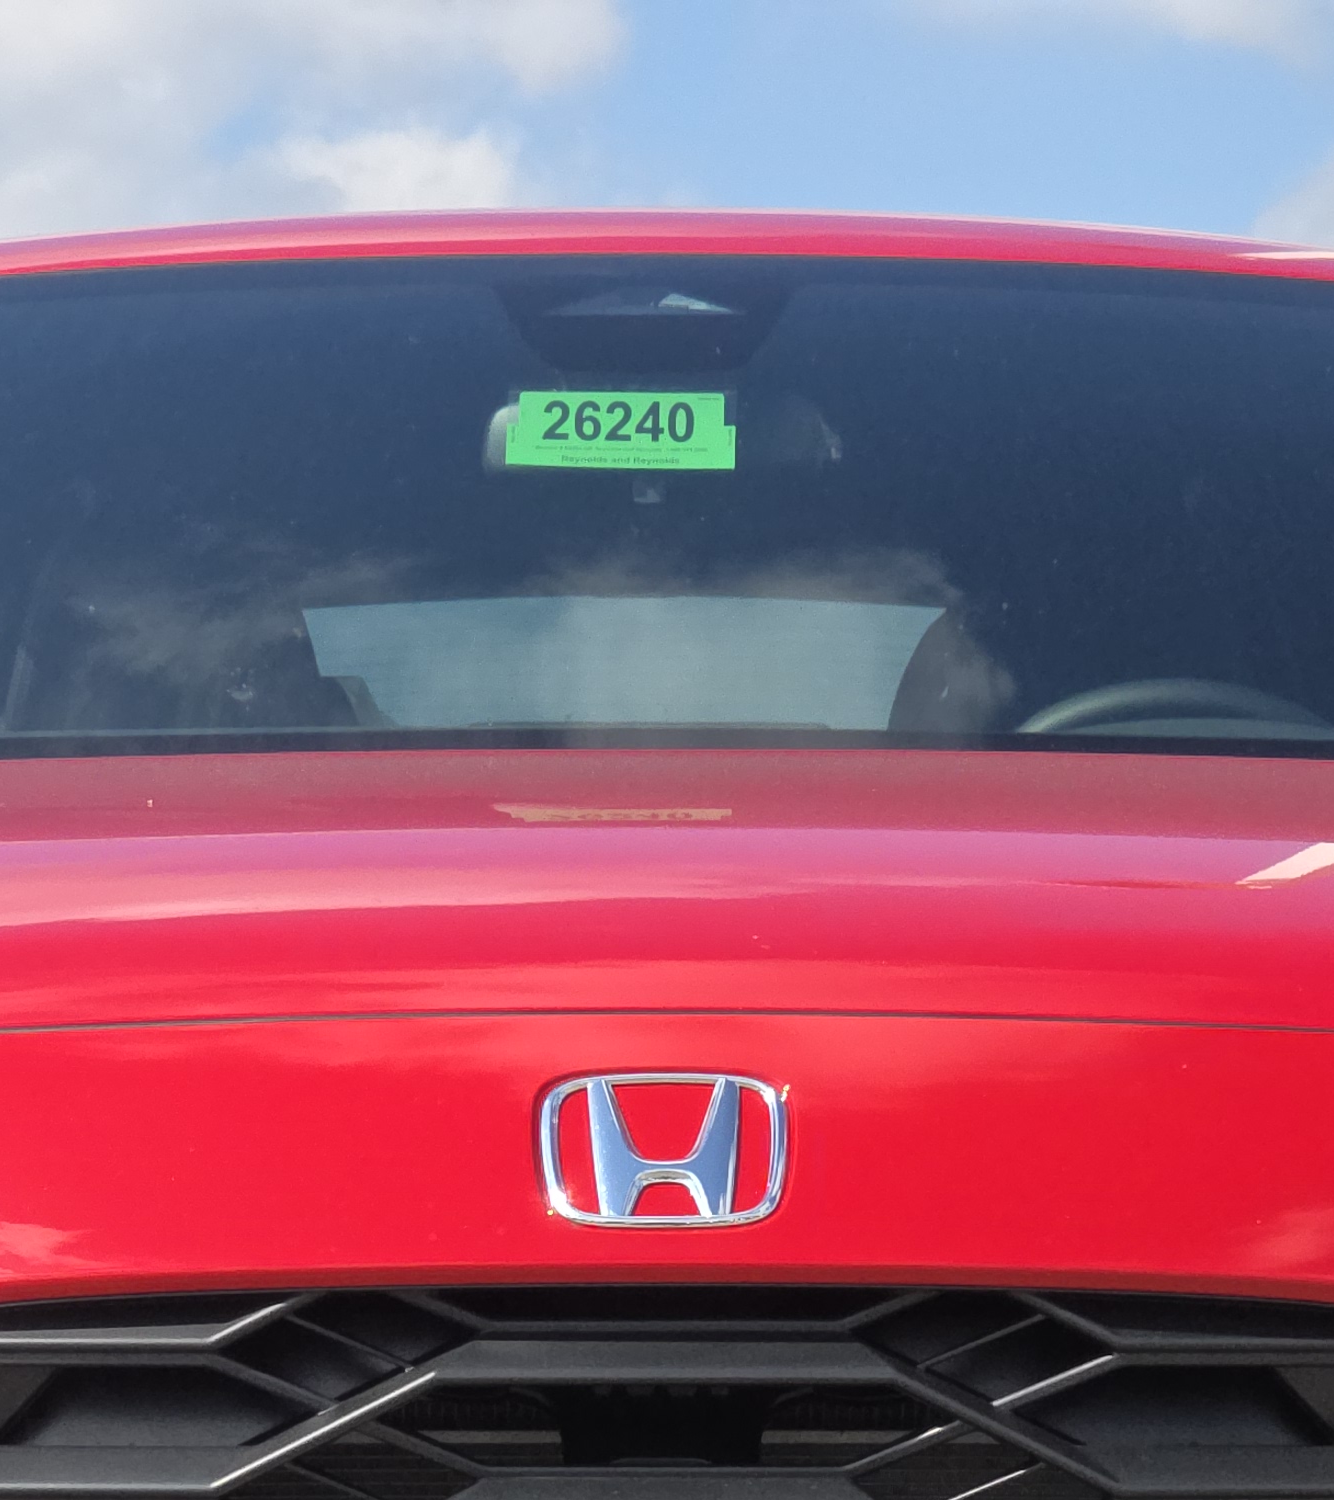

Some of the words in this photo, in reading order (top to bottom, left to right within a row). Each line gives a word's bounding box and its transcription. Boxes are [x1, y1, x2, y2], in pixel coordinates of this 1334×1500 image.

[542, 400, 695, 443] 26240
[561, 454, 608, 465] Reynolds
[611, 456, 630, 464] and
[633, 456, 680, 466] Reynolds
